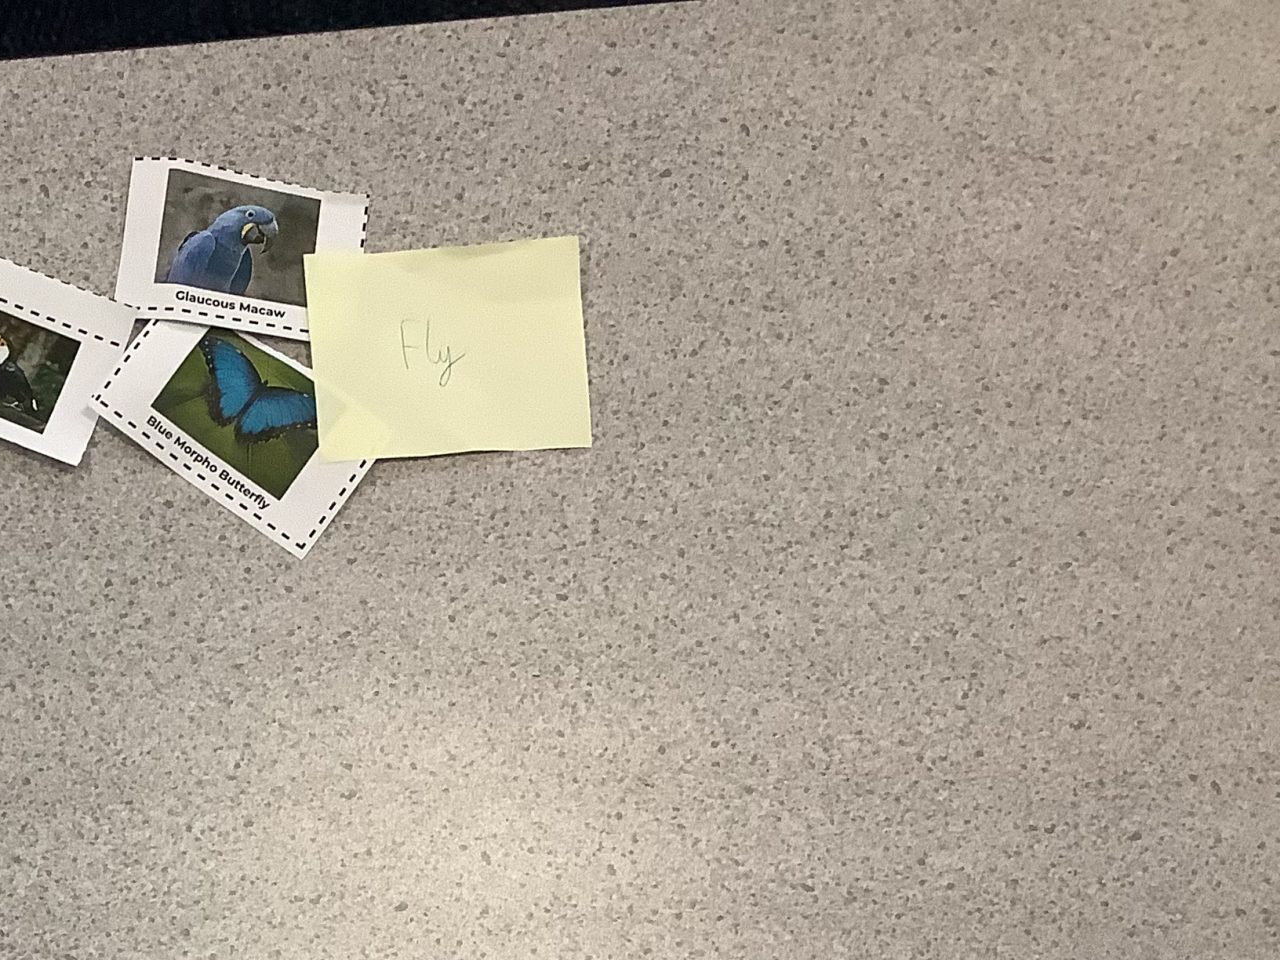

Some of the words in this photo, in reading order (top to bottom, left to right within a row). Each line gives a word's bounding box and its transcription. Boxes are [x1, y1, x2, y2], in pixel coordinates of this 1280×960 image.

[175, 290, 236, 310] Glaucous
[239, 302, 286, 318] Macaw
[400, 318, 466, 387] Fly
[146, 415, 173, 440] Blue
[173, 436, 218, 473] Morpho
[218, 469, 271, 510] Butterfly
